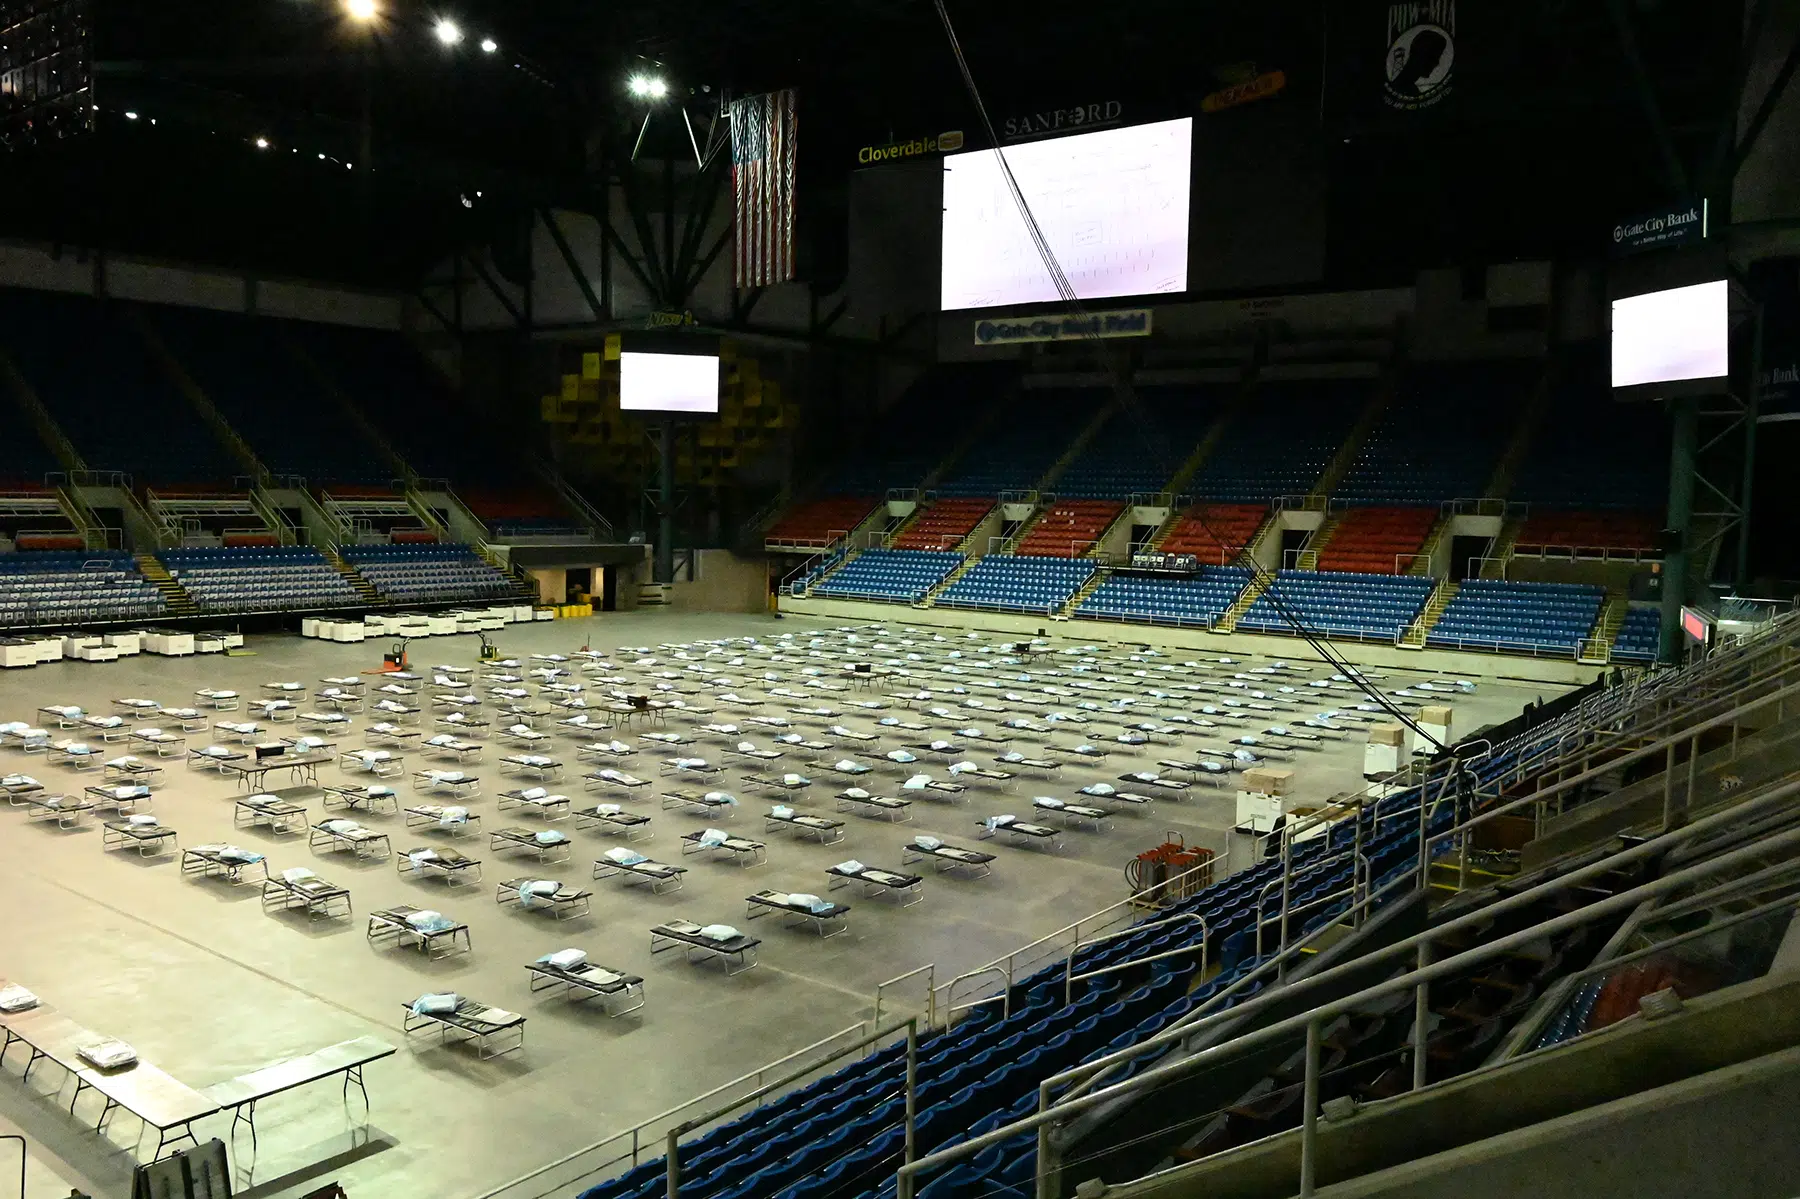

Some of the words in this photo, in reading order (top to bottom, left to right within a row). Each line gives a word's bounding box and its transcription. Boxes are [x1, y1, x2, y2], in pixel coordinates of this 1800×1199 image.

[858, 137, 937, 165] Cloverdale
[1624, 222, 1645, 238] Gate
[1645, 217, 1667, 232] City
[1667, 207, 1698, 227] Bank
